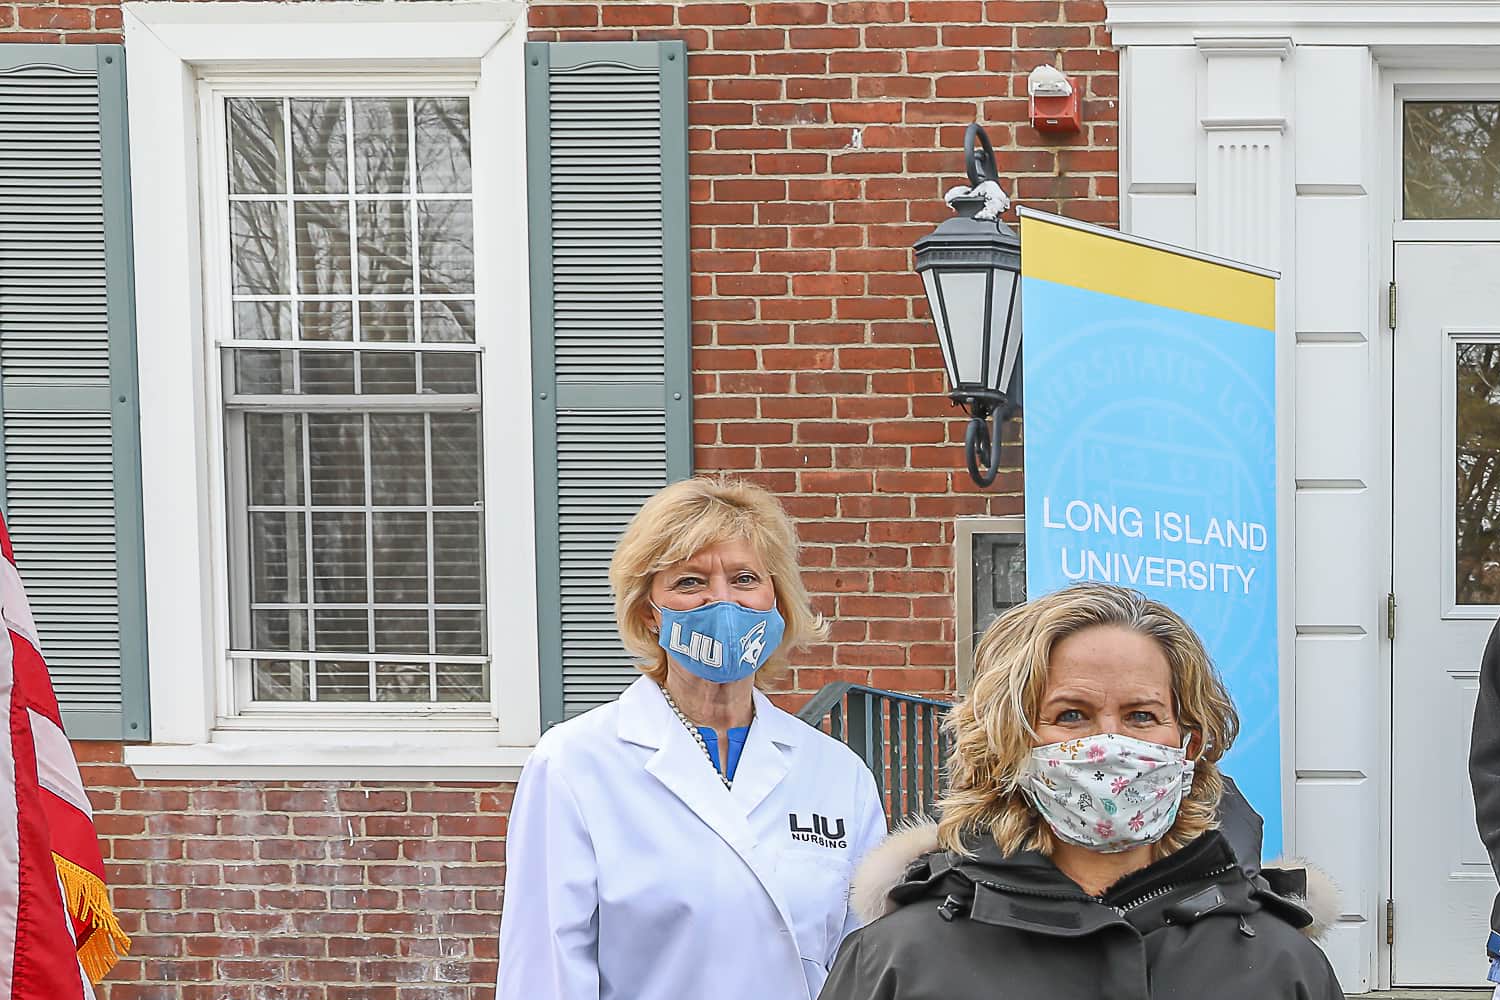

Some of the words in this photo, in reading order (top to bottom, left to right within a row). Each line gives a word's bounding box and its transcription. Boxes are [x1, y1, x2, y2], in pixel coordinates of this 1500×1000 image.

[1043, 496, 1144, 539] LONG
[1154, 510, 1268, 552] ISLAND
[1061, 546, 1256, 595] UNIVERSITY
[669, 621, 724, 669] LIU
[788, 812, 847, 841] LIU
[791, 832, 848, 849] NURSING
